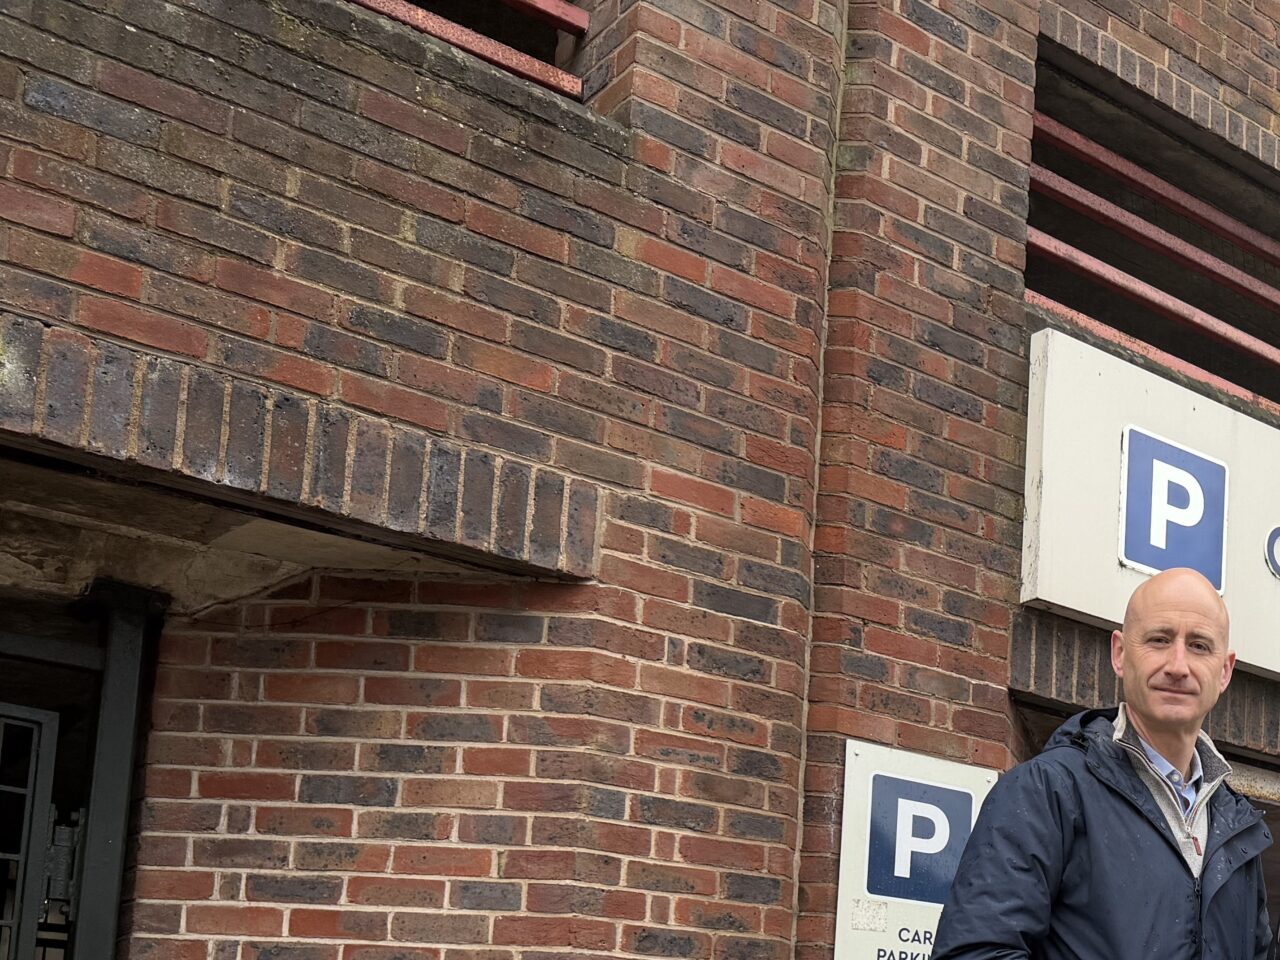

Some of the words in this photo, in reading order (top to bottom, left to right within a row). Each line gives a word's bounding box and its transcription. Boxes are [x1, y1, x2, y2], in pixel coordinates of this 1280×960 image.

[1150, 458, 1205, 550] P
[894, 797, 950, 878] P
[898, 927, 933, 945] CAR
